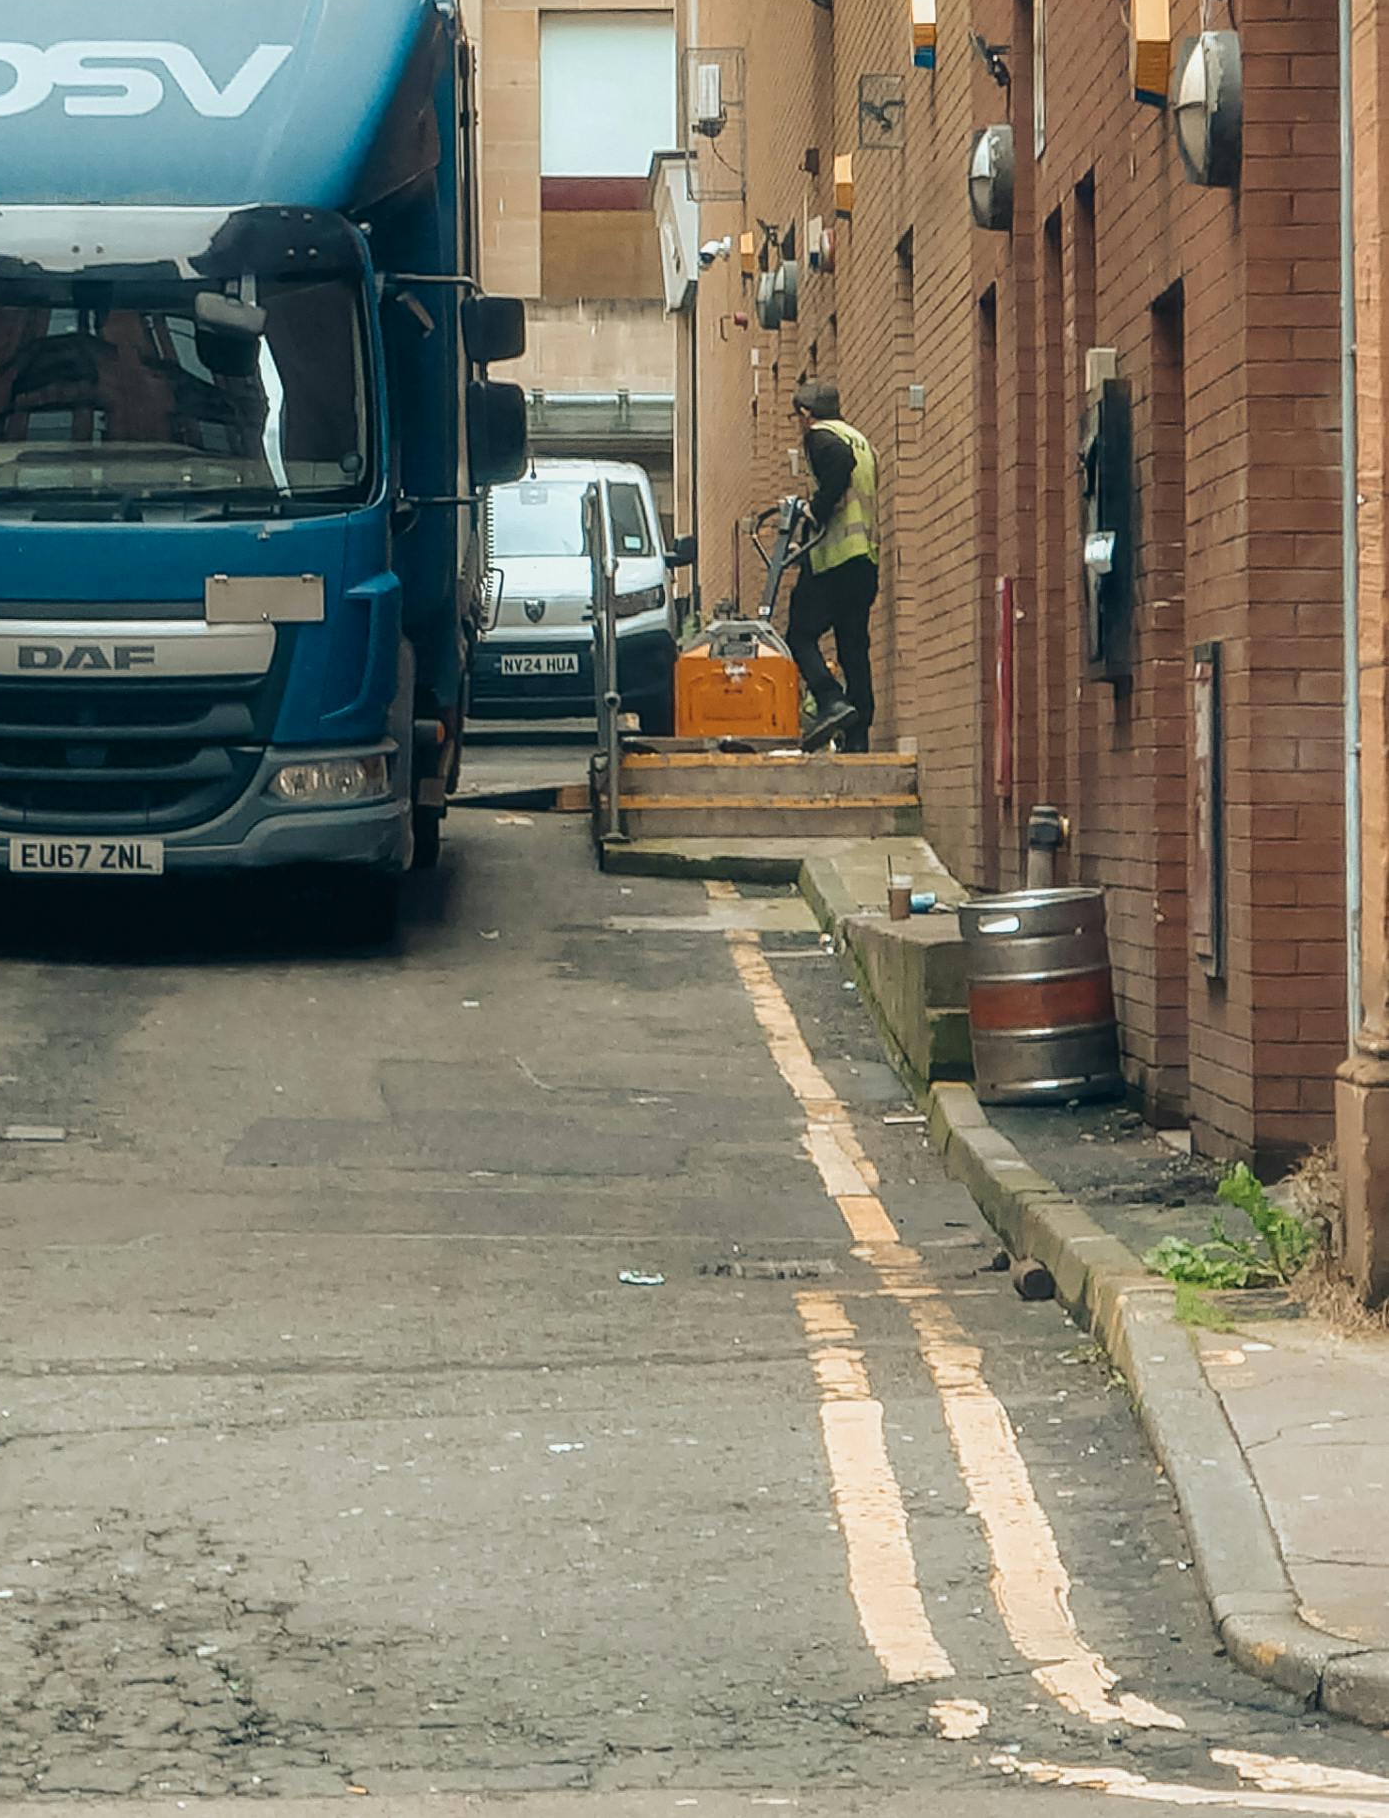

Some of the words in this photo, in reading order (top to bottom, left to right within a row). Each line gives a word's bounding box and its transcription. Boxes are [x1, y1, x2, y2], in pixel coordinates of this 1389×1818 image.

[18, 645, 155, 670] DAF
[504, 658, 542, 672] NV24
[546, 657, 576, 671] HUA
[21, 844, 92, 869] EU67
[100, 844, 153, 869] ZNL
